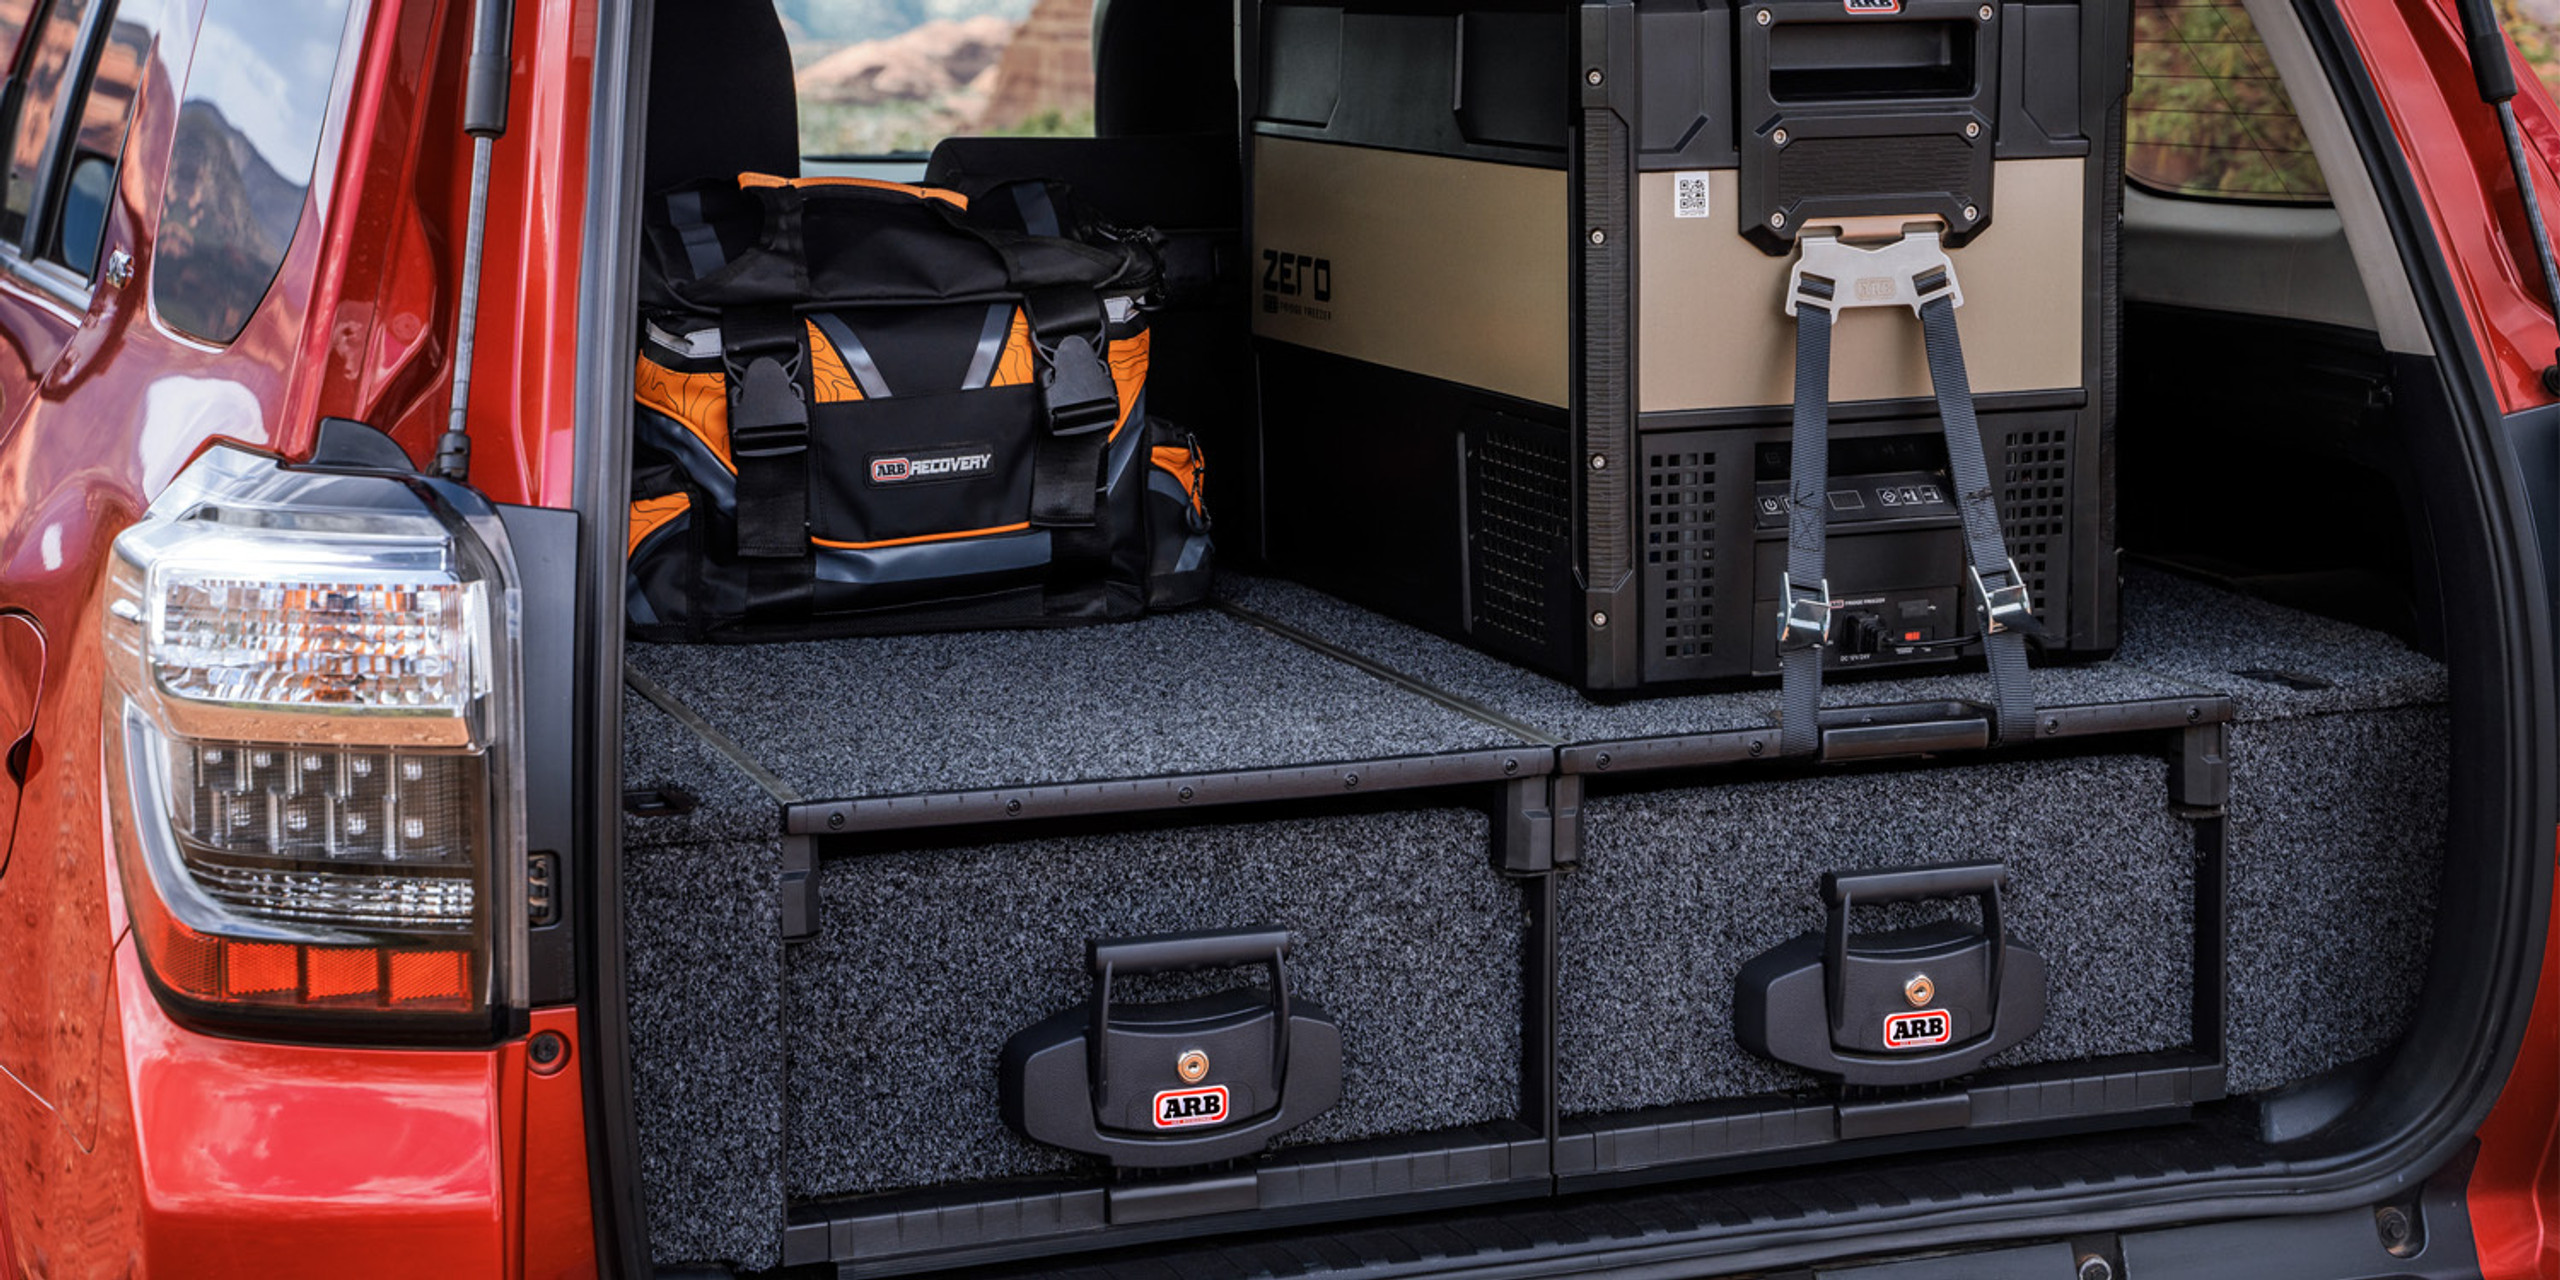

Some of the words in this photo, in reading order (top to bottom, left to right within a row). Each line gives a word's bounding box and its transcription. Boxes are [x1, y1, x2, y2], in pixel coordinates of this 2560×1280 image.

[877, 463, 907, 477] ARB
[910, 454, 992, 476] RECOVERY
[1840, 654, 1849, 662] DC
[1892, 1017, 1944, 1040] ARB
[1163, 1095, 1221, 1119] ARB
